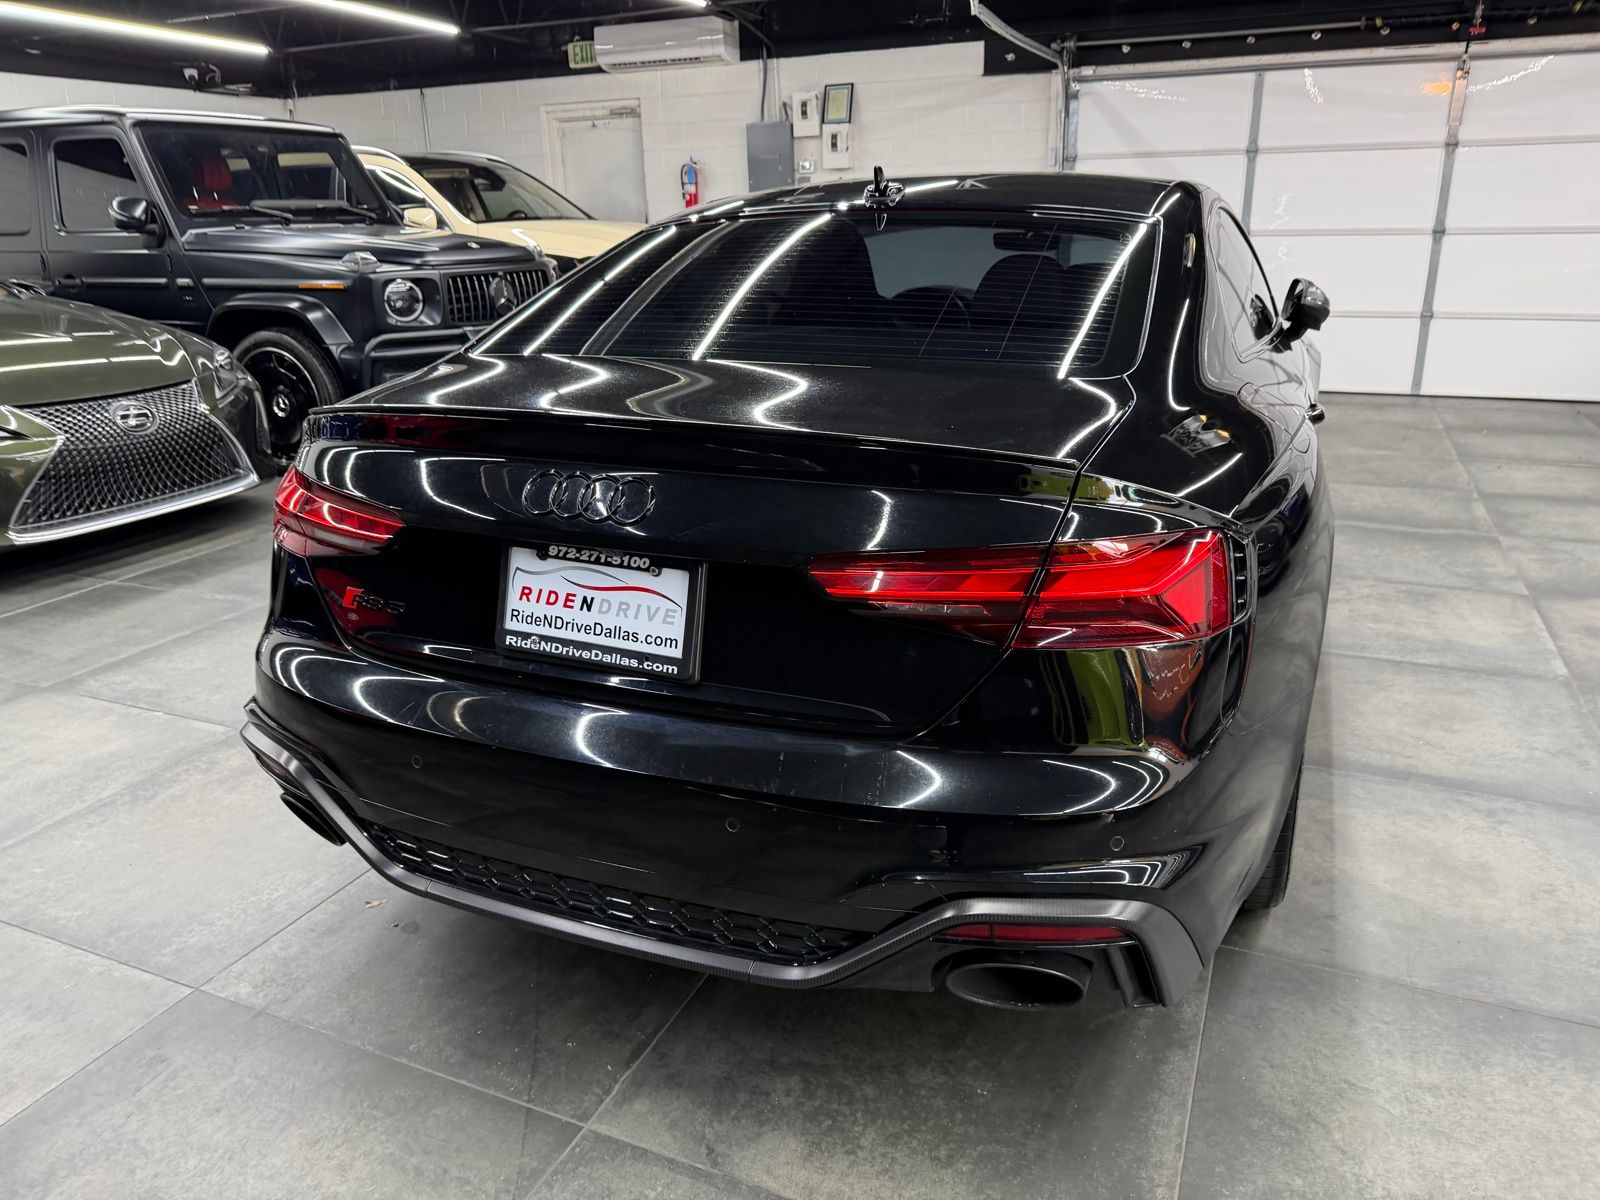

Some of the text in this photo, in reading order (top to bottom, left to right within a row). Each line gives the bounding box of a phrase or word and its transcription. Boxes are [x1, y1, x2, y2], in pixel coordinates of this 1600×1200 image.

[573, 43, 594, 65] EXIT
[548, 545, 650, 569] 972-271-5100
[510, 608, 679, 649] RideNDriveDallas.com
